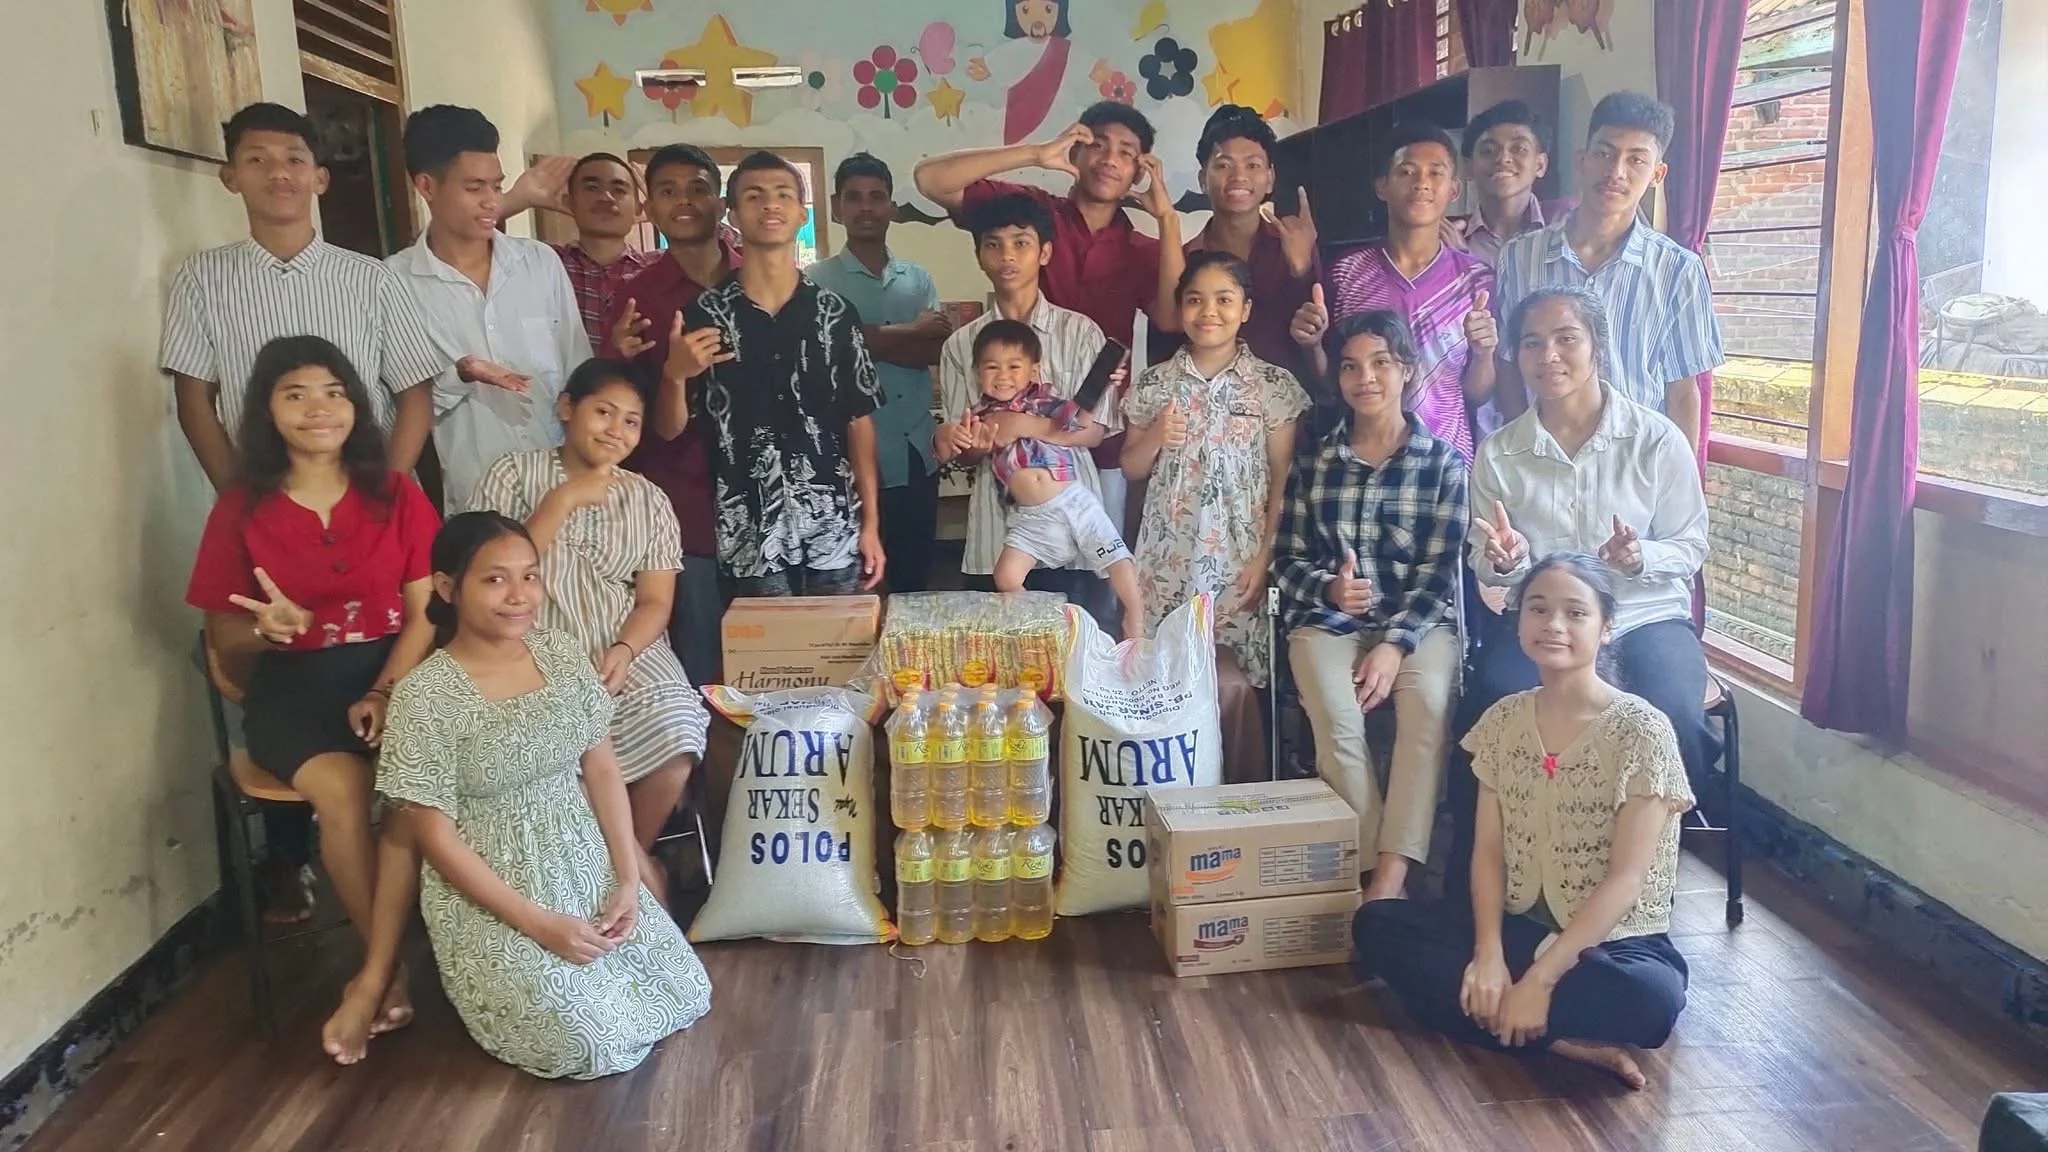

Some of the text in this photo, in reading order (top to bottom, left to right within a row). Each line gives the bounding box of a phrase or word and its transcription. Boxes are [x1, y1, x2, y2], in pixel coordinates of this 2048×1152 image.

[1131, 678, 1158, 696] NETTO
[1118, 700, 1164, 716] SINAR
[739, 729, 854, 787] ARUM
[1077, 729, 1199, 786] ARUM
[747, 788, 820, 824] SEKAR
[1096, 795, 1146, 827] KAR
[751, 831, 851, 865] POLOS
[1190, 847, 1241, 871] mama
[1199, 916, 1249, 940] mama
